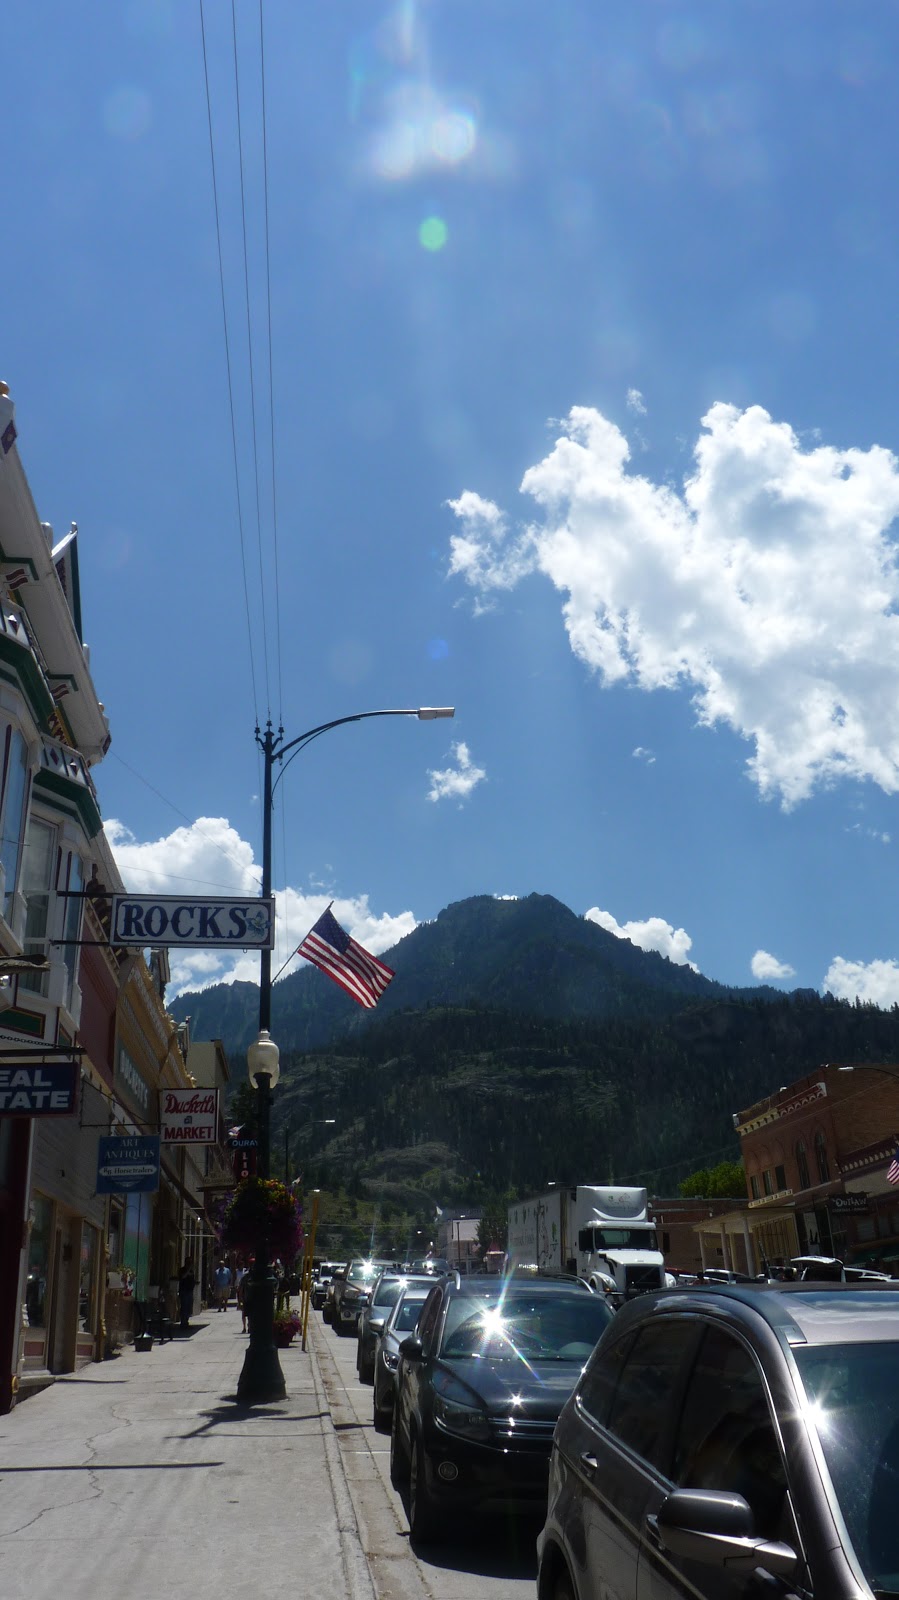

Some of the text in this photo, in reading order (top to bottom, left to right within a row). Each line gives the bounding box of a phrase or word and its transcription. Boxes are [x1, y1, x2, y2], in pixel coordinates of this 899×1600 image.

[120, 903, 250, 939] ROCKS
[0, 1069, 53, 1088] EAL
[0, 1090, 70, 1109] TATE
[164, 1093, 215, 1114] Duckett's
[119, 1138, 140, 1147] ART
[164, 1126, 214, 1140] MARKET
[104, 1149, 156, 1160] ANTIQUES
